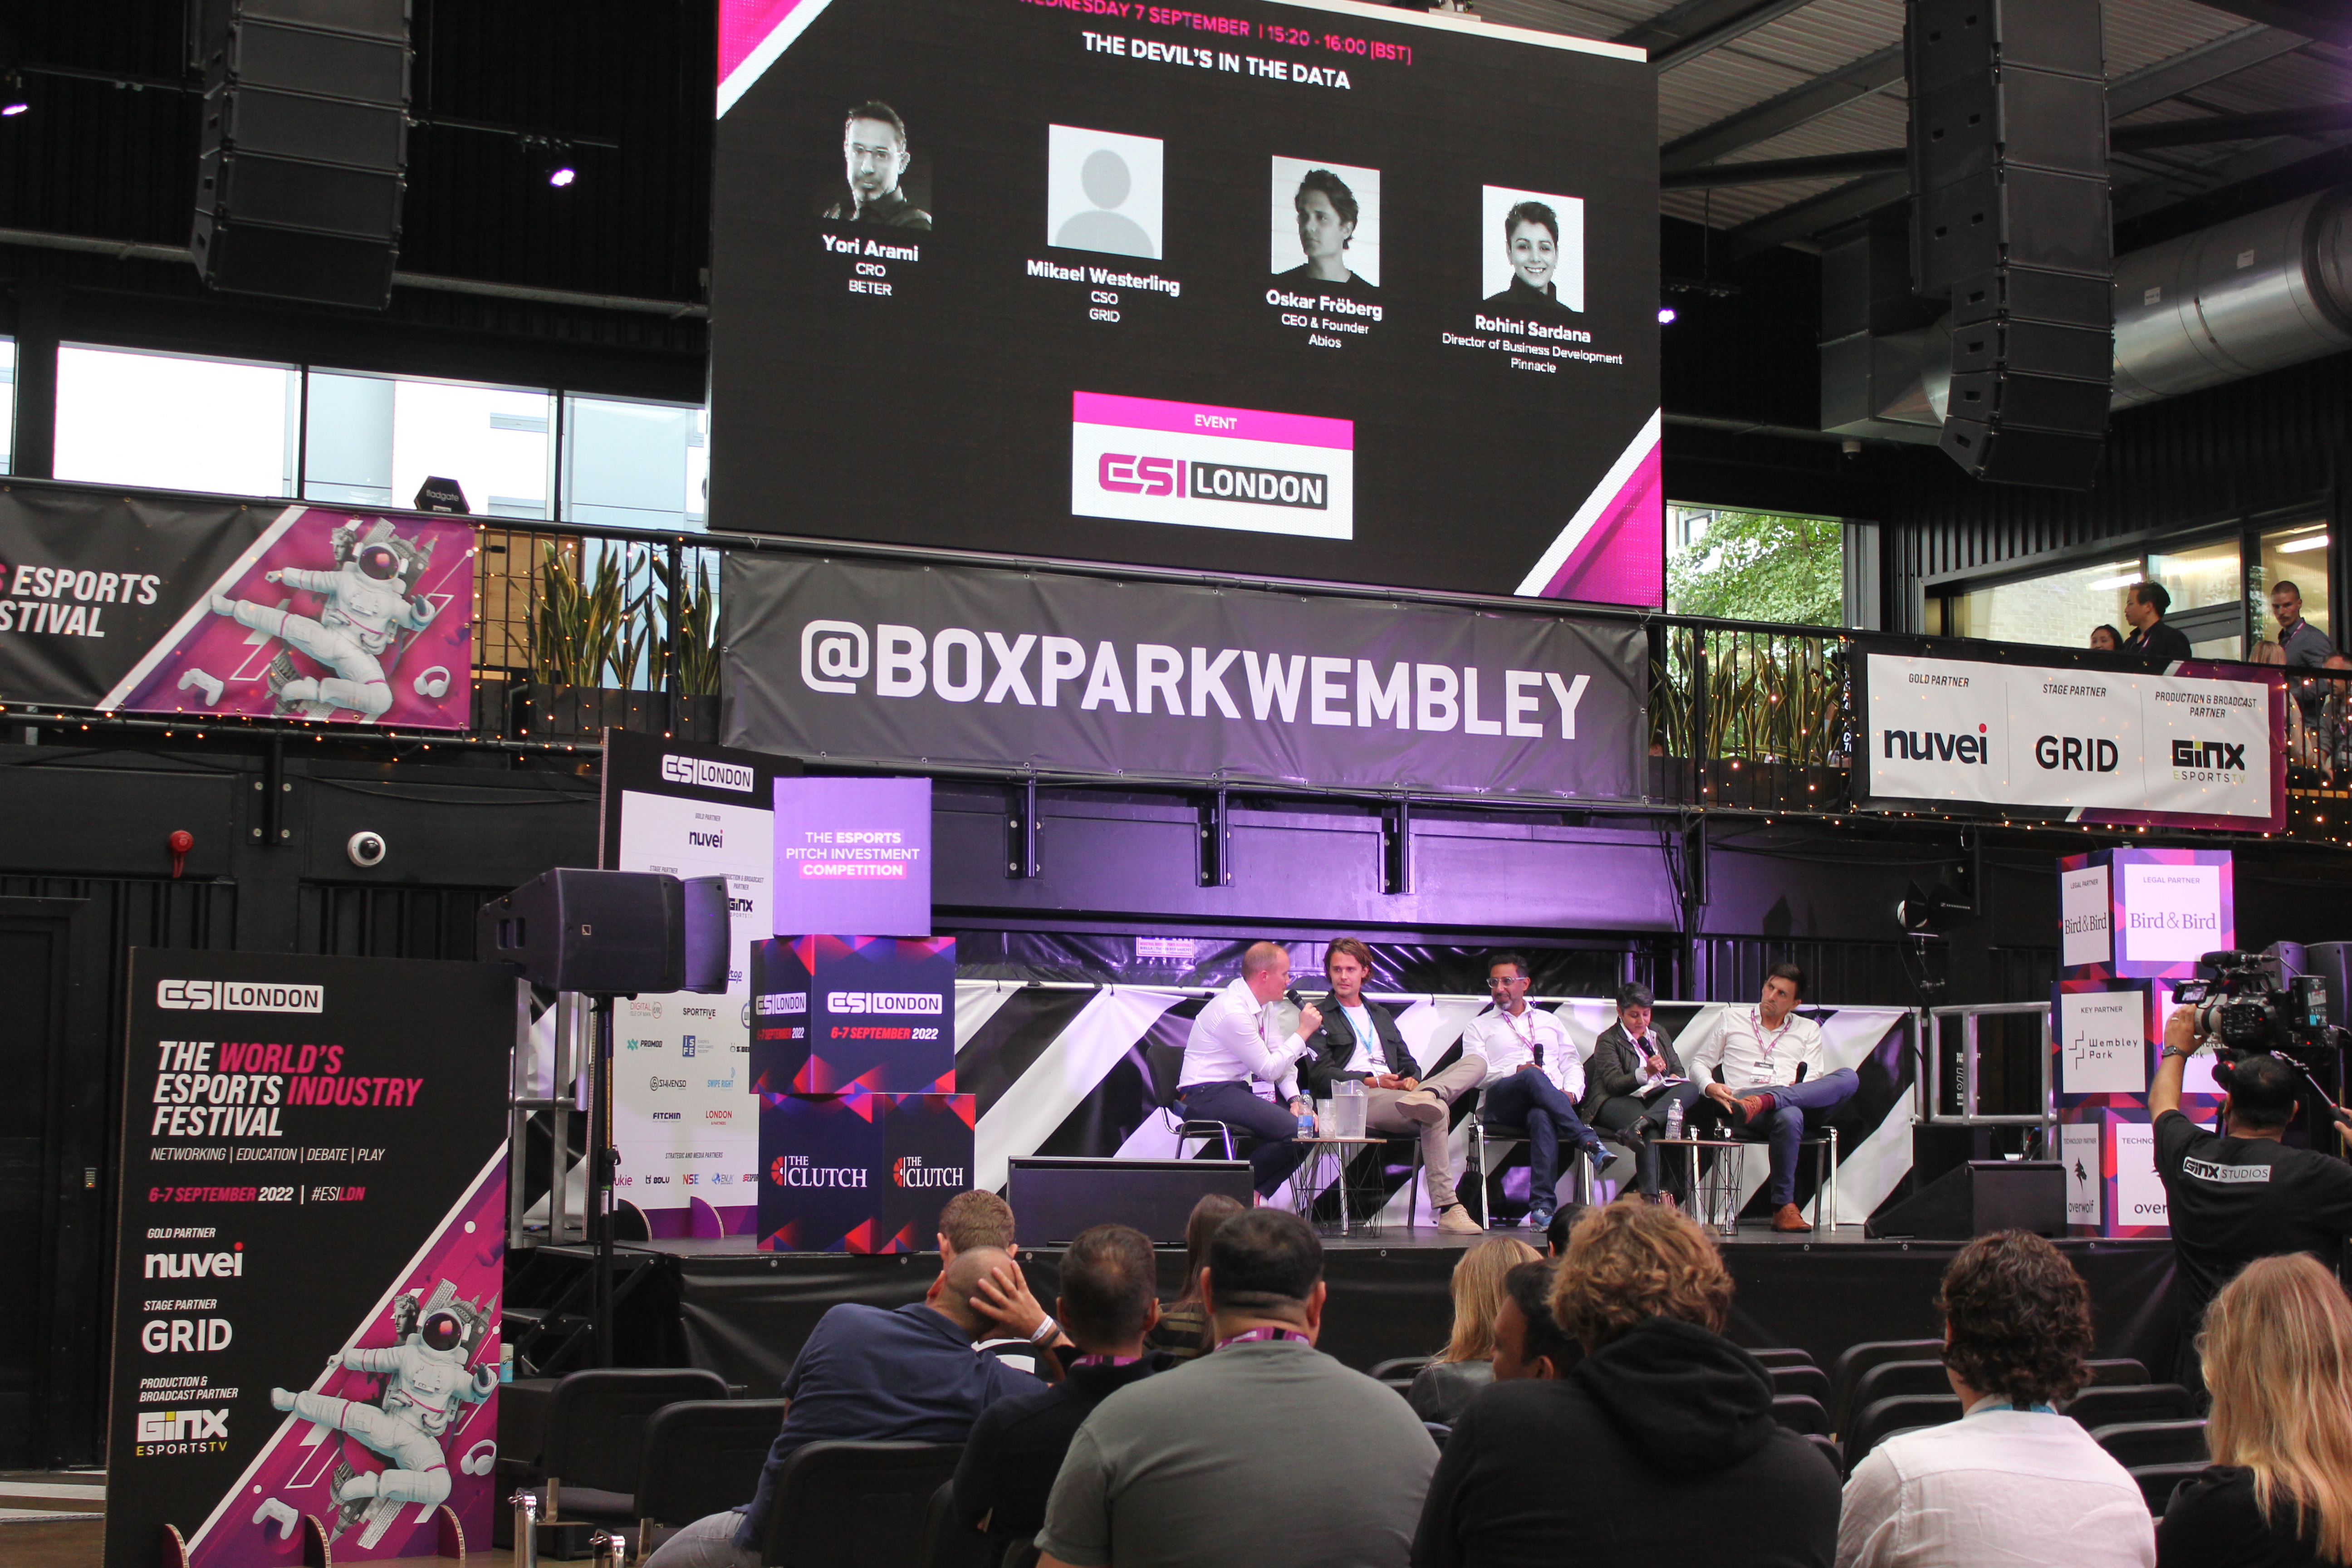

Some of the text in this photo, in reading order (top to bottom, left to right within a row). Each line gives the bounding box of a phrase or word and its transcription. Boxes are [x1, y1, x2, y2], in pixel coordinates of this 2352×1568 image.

[1020, 0, 1412, 65] NESDAY 7 SEPTEMBER 15:20 16:00 [BST]
[1083, 31, 1351, 90] THE DEVIL'S IN THE DATA
[822, 234, 919, 262] Yori Arami
[855, 262, 887, 278] CRO
[1027, 259, 1181, 297] Mikael Westerling
[848, 279, 892, 297] BETER
[1091, 290, 1119, 306] CSO
[1266, 289, 1383, 322] Oskar Fröberg
[1089, 308, 1121, 323] GRID
[1281, 314, 1369, 335] CEO & Founder
[1475, 314, 1591, 344] Rohini Sardana
[1308, 333, 1342, 349] Abios
[1442, 333, 1623, 367] Director of Business Development
[1510, 357, 1557, 374] Pinnacle
[1194, 414, 1237, 430] EVENT
[1196, 466, 1323, 505] LONDON
[11, 565, 161, 605] ESPORTS
[801, 620, 1591, 740] @BOXPARKWEMBLEY
[1908, 673, 1970, 688] GOLD PARTNER
[2043, 683, 2107, 698] STAGE PARTNER
[2155, 691, 2257, 708] PRODUCTION & BROADCAST
[2190, 706, 2226, 719] PARTNER
[1884, 723, 1988, 764] nuvei
[2035, 735, 2118, 773] GRID
[701, 764, 751, 787] LONDON
[705, 813, 721, 822] PARTNER
[689, 829, 723, 848] nuvei
[805, 832, 901, 843] THE ESPORTS
[786, 848, 920, 860] PITCH INVESTMENT
[803, 864, 903, 876] COMPETITION
[2070, 878, 2098, 889] LEGAL PARTNER
[2065, 912, 2107, 935] Bird & Bird
[2130, 911, 2216, 930] Bird & Bird
[229, 987, 318, 1008] LONDON
[776, 996, 805, 1010] LONDON
[877, 997, 939, 1010] LONDON
[630, 1002, 651, 1011] DIGITAL
[683, 1008, 716, 1017] SPORTFIVE
[2094, 1005, 2123, 1014] PARTNER
[765, 1028, 792, 1040] SEPTEMBER
[792, 1027, 805, 1039] 2022
[830, 1027, 939, 1039] 6-7 SEPTEMBER 2022
[640, 1040, 663, 1048] PROMOD
[2089, 1038, 2138, 1048] Wembley
[158, 1041, 344, 1074] THE WORLD'S
[2089, 1050, 2112, 1059] Park
[2190, 1050, 2204, 1059] ark
[152, 1074, 424, 1107] ESPORTS INDUSTRY
[707, 1080, 720, 1088] SWIPE
[151, 1107, 283, 1137] FESTIVAL
[151, 1147, 385, 1161] NETWORKING EDUCATION DEBATE PLAY
[789, 1156, 808, 1166] THE
[906, 1156, 922, 1166] THE
[614, 1174, 632, 1186] ukie
[682, 1174, 699, 1185] NSE
[788, 1167, 867, 1187] CLUTCH
[906, 1167, 964, 1187] CLUTCH
[2222, 1169, 2269, 1179] STUDIOS
[148, 1186, 366, 1202] 6-7 SEPTEMBER 2022 #ESILDN
[2068, 1200, 2094, 1213] overwolf
[147, 1227, 216, 1239] GOLD PARTNER
[144, 1241, 244, 1279] nuvei
[143, 1298, 217, 1311] STAGE PARTNER
[142, 1318, 233, 1353] GRID
[140, 1376, 207, 1389] PRODUCTION &
[139, 1387, 239, 1402] BROADCAST PARTNER
